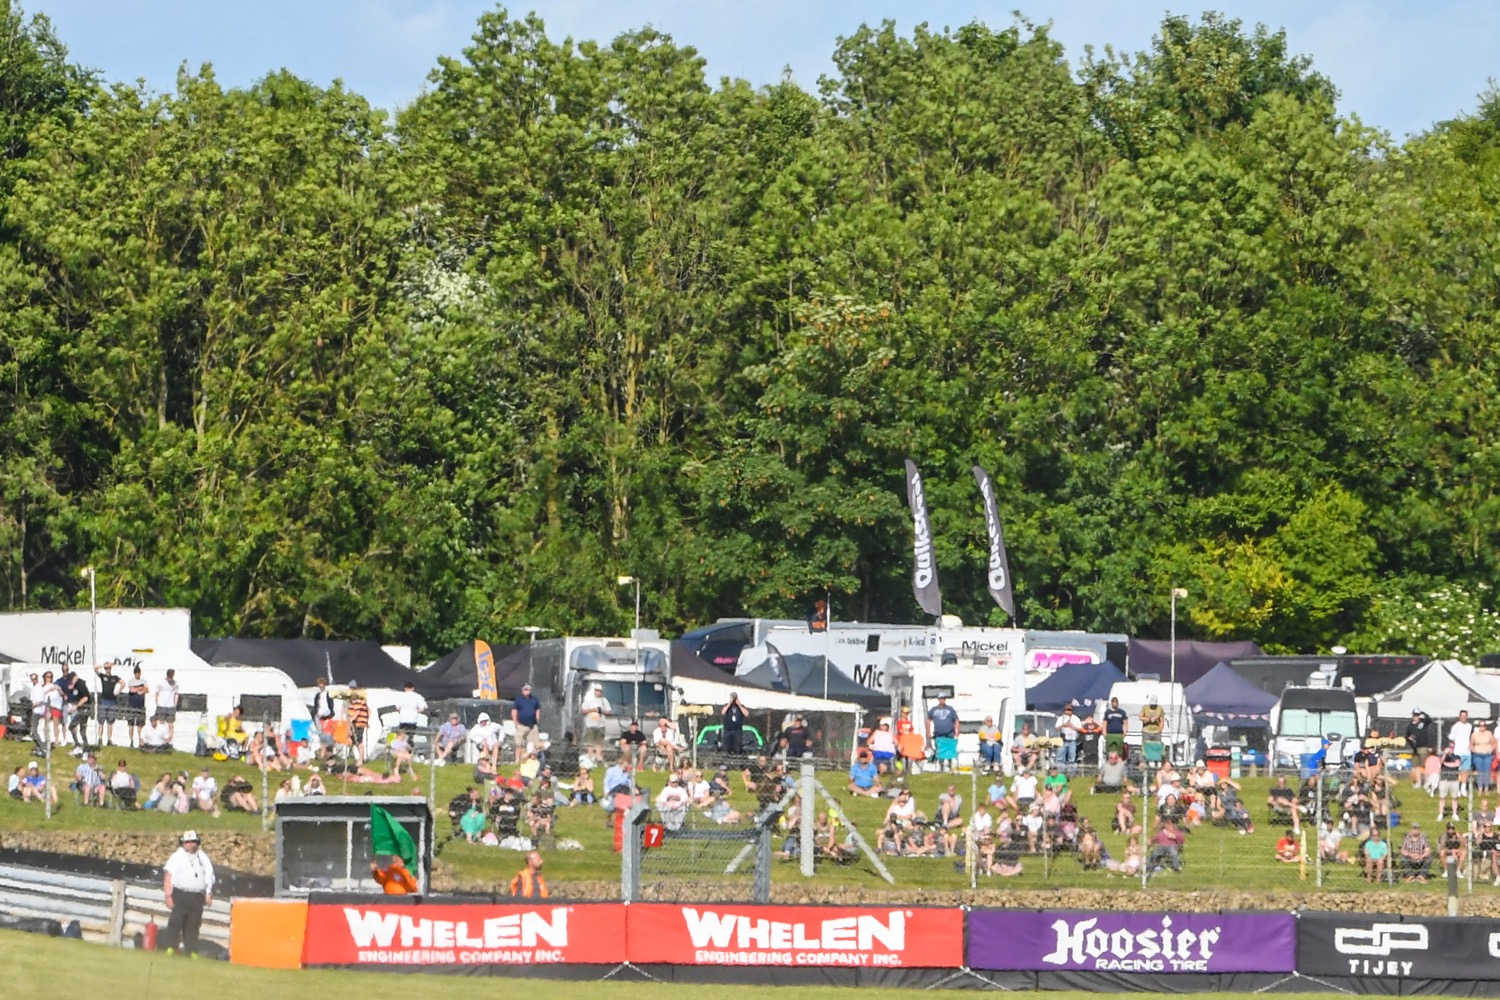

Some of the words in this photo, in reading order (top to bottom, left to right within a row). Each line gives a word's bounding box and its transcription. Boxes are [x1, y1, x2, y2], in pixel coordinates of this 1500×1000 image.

[41, 645, 86, 665] Mickel
[854, 664, 885, 689] Mic
[650, 828, 659, 844] 7
[343, 906, 569, 948] WHELEN
[682, 906, 905, 951] WHELEN
[1042, 914, 1221, 965] Hoosier
[358, 950, 456, 963] ENGINEERING
[460, 951, 532, 963] COMPANY
[535, 950, 565, 962] INC.
[695, 950, 793, 964] ENGINEERING
[796, 952, 868, 965] COMPANY
[873, 953, 902, 965] INC.
[1095, 958, 1164, 971] RACING
[1170, 959, 1208, 972] TIRE
[1349, 960, 1414, 976] TIJEY
